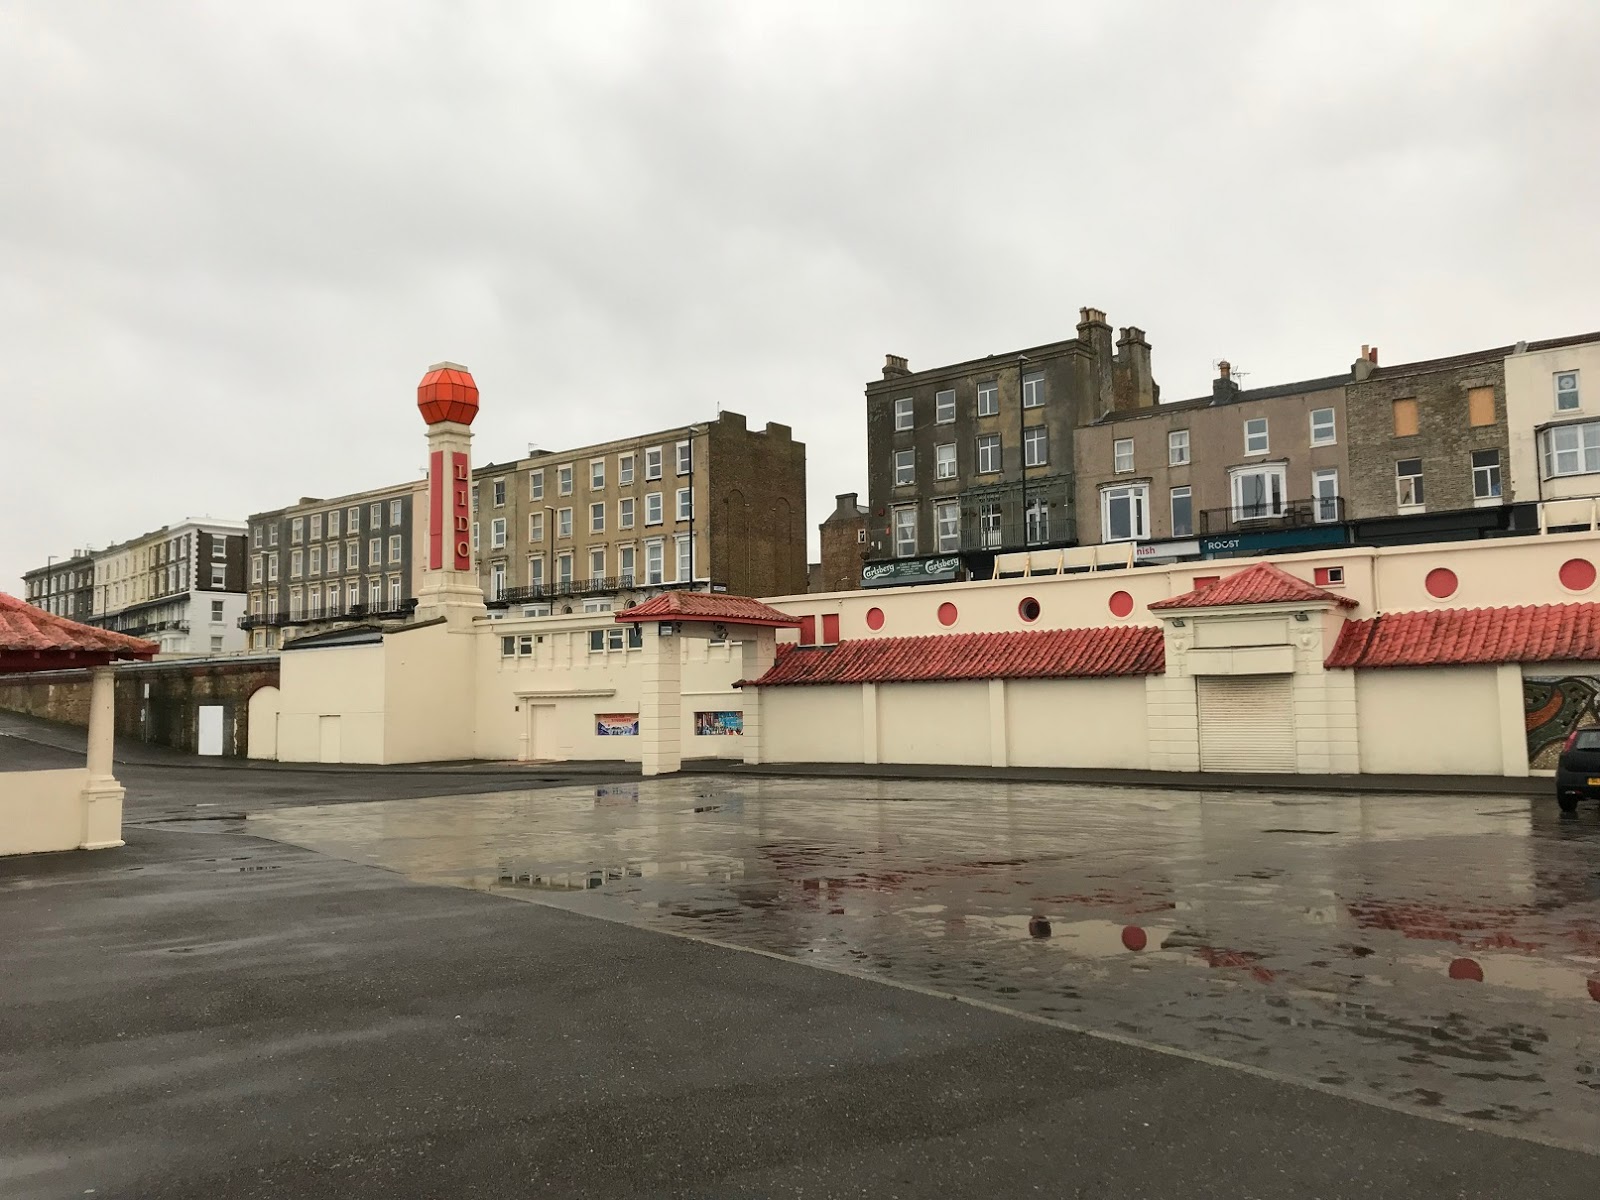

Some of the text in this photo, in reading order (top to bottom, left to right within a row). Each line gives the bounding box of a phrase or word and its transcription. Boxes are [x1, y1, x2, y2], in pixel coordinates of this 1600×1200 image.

[455, 464, 470, 558] LIDO
[1208, 539, 1240, 550] ROOST
[862, 563, 895, 580] Carlsberg
[925, 557, 959, 574] Carlsberg
